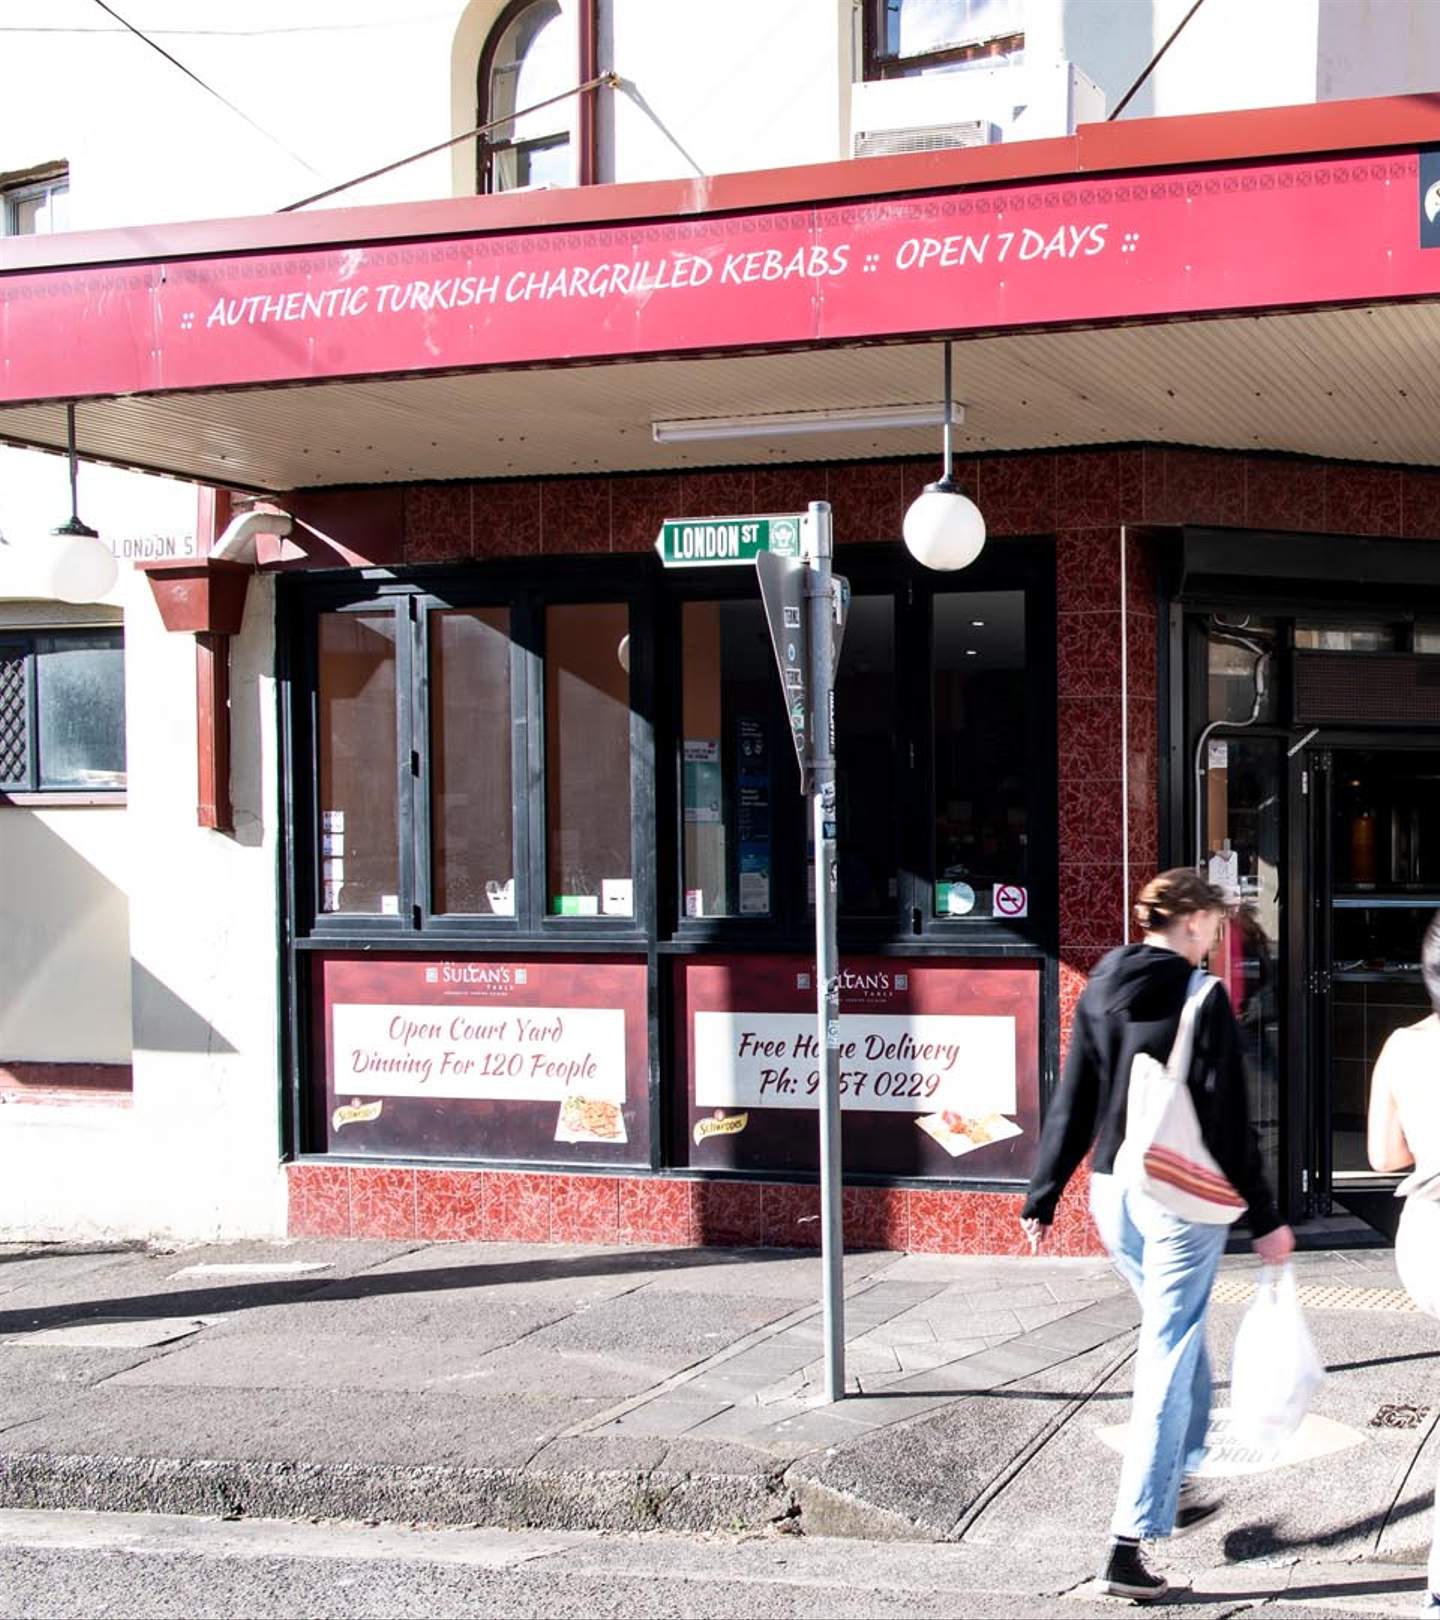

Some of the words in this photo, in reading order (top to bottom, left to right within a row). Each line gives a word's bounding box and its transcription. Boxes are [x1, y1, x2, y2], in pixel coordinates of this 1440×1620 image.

[206, 286, 369, 328] AUTHENTIC
[376, 275, 499, 313] TURKISH
[505, 256, 712, 302] CHARGRILLED
[720, 245, 850, 285] KEBABS
[896, 233, 992, 270] OPEN
[998, 232, 1014, 262] 7
[1018, 224, 1108, 260] DAYS
[112, 536, 175, 559] LONDON
[673, 526, 738, 559] LONDON
[741, 524, 759, 542] ST
[443, 962, 510, 983] SULTAN'S
[389, 1015, 442, 1046] Open
[450, 1016, 506, 1042] Court
[516, 1018, 564, 1043] Yard
[352, 1049, 433, 1084] Dinning
[440, 1051, 474, 1076] For
[480, 1053, 523, 1077] 120
[530, 1053, 598, 1086] People
[738, 1033, 785, 1059] Free
[793, 1034, 856, 1060] Hoe
[864, 1032, 961, 1071] Delivery
[759, 1069, 798, 1096] Ph:
[806, 1071, 867, 1096] 957
[874, 1072, 940, 1099] 0229
